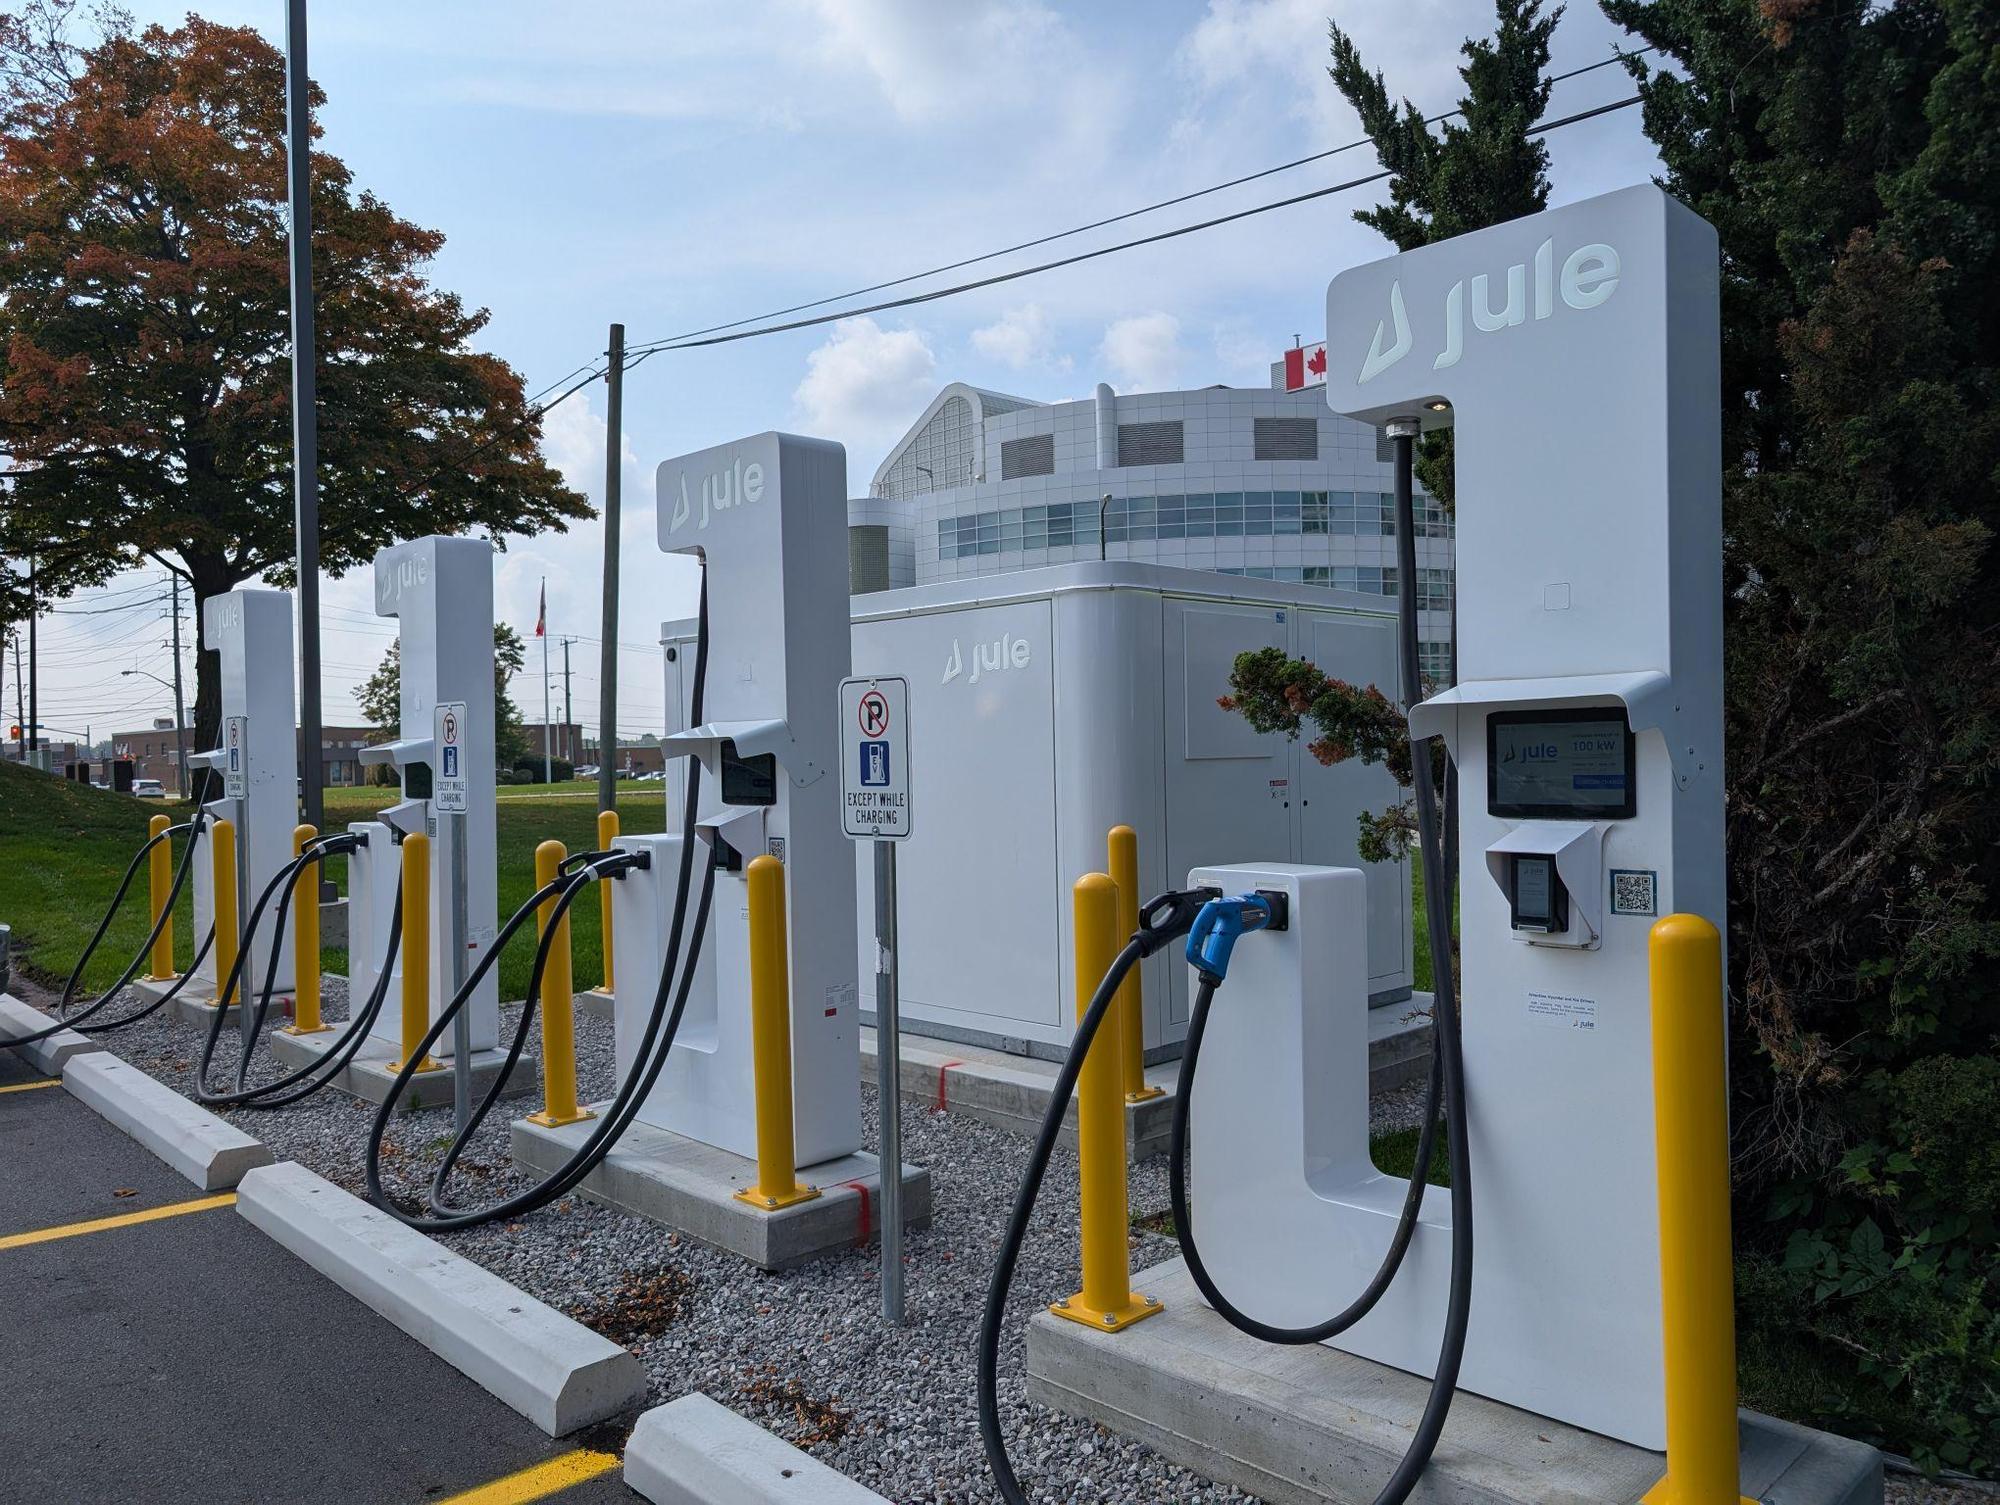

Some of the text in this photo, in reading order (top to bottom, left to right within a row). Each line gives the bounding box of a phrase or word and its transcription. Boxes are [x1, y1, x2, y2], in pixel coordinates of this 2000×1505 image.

[1433, 235, 1622, 370] jule
[696, 457, 764, 530] jule
[395, 556, 429, 602] jule
[968, 631, 1031, 684] jule
[1520, 742, 1558, 764] jule
[1573, 740, 1616, 752] 100 kW
[848, 792, 905, 807] EXCEPT WHILE
[855, 809, 898, 825] CHARGING
